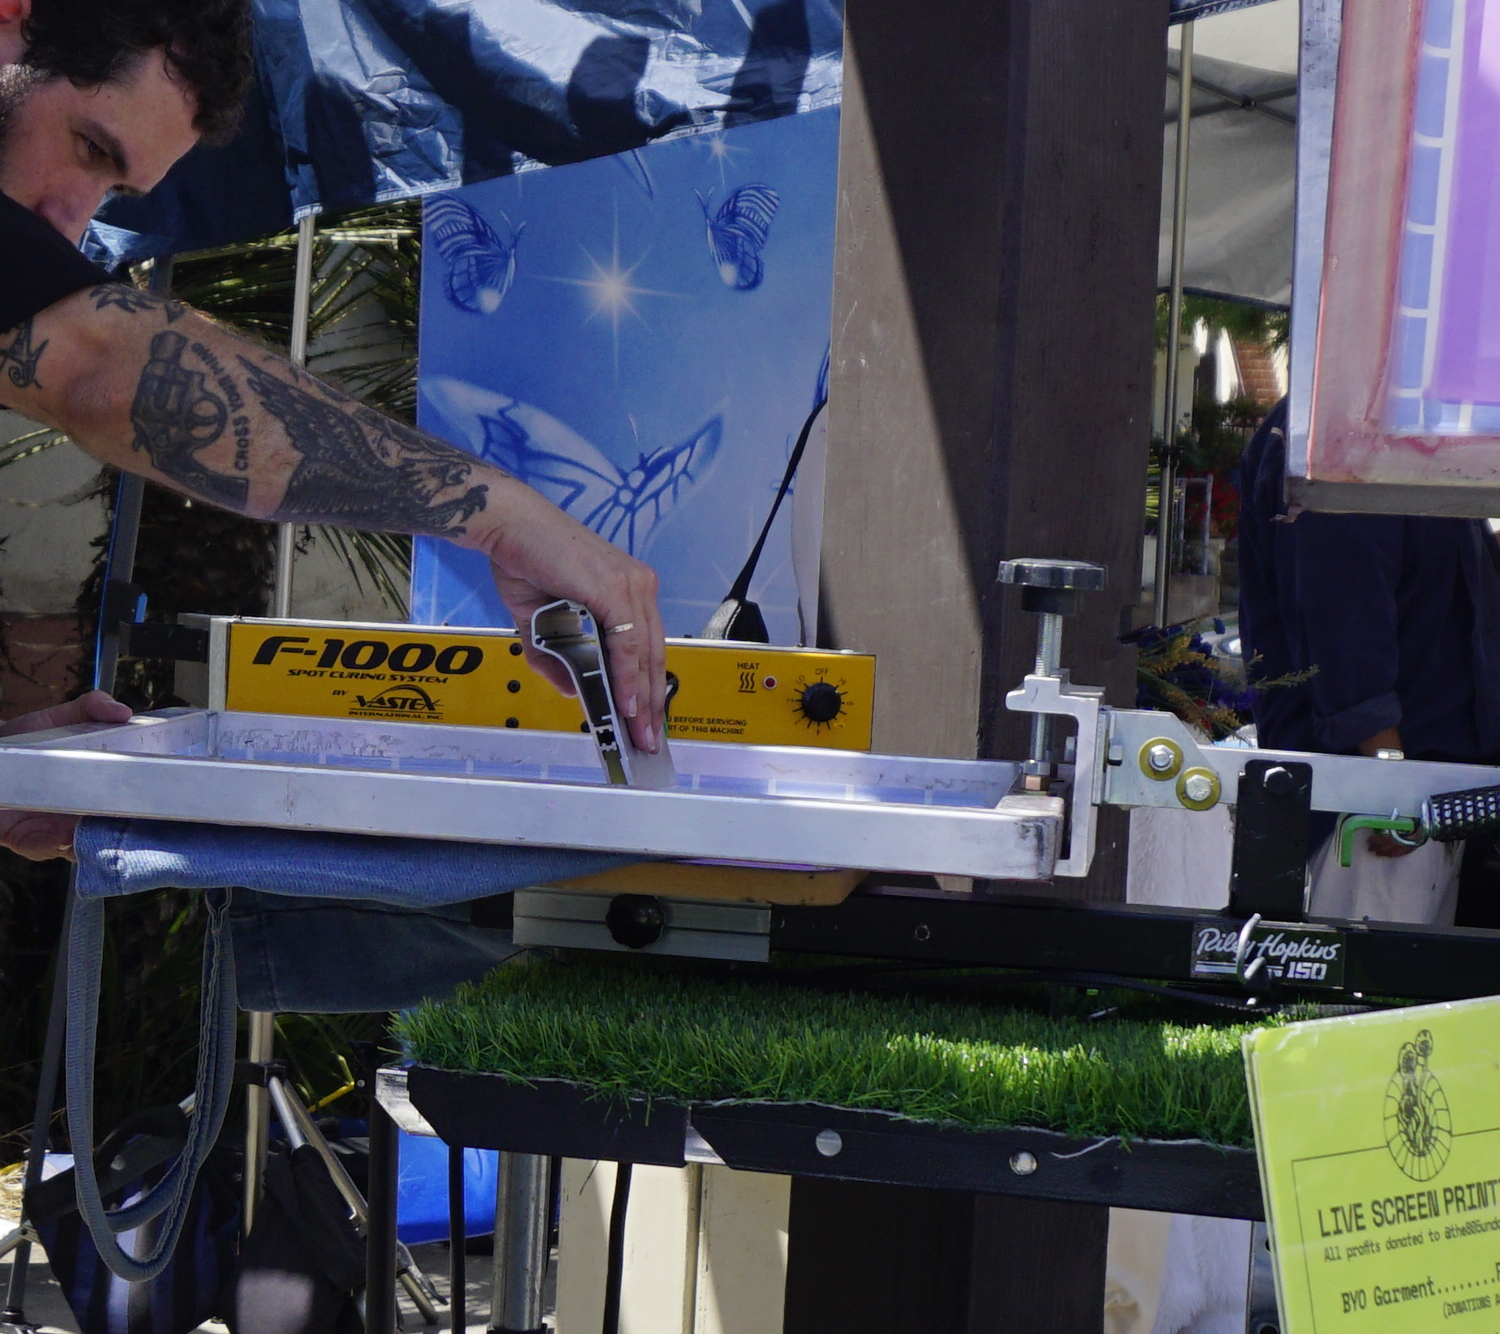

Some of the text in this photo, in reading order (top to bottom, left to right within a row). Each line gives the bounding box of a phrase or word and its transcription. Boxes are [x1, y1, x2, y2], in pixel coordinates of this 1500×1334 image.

[252, 635, 484, 675] F-1000
[287, 669, 449, 684] SPOT CURING SYSTEM
[353, 694, 442, 711] VASTEX
[674, 716, 704, 724] BEFORE
[706, 717, 747, 726] SERVICING
[1257, 932, 1341, 965] Hopkins
[1287, 961, 1328, 981] 150
[1318, 1202, 1367, 1238] LIVE
[1370, 1189, 1440, 1229] SCREEN
[1324, 1244, 1343, 1263] All
[1346, 1240, 1382, 1262] profits
[1385, 1230, 1424, 1250] donated
[1429, 1228, 1441, 1243] to
[1341, 1289, 1368, 1314] BYO
[1443, 1295, 1492, 1319] (DONATIONS
